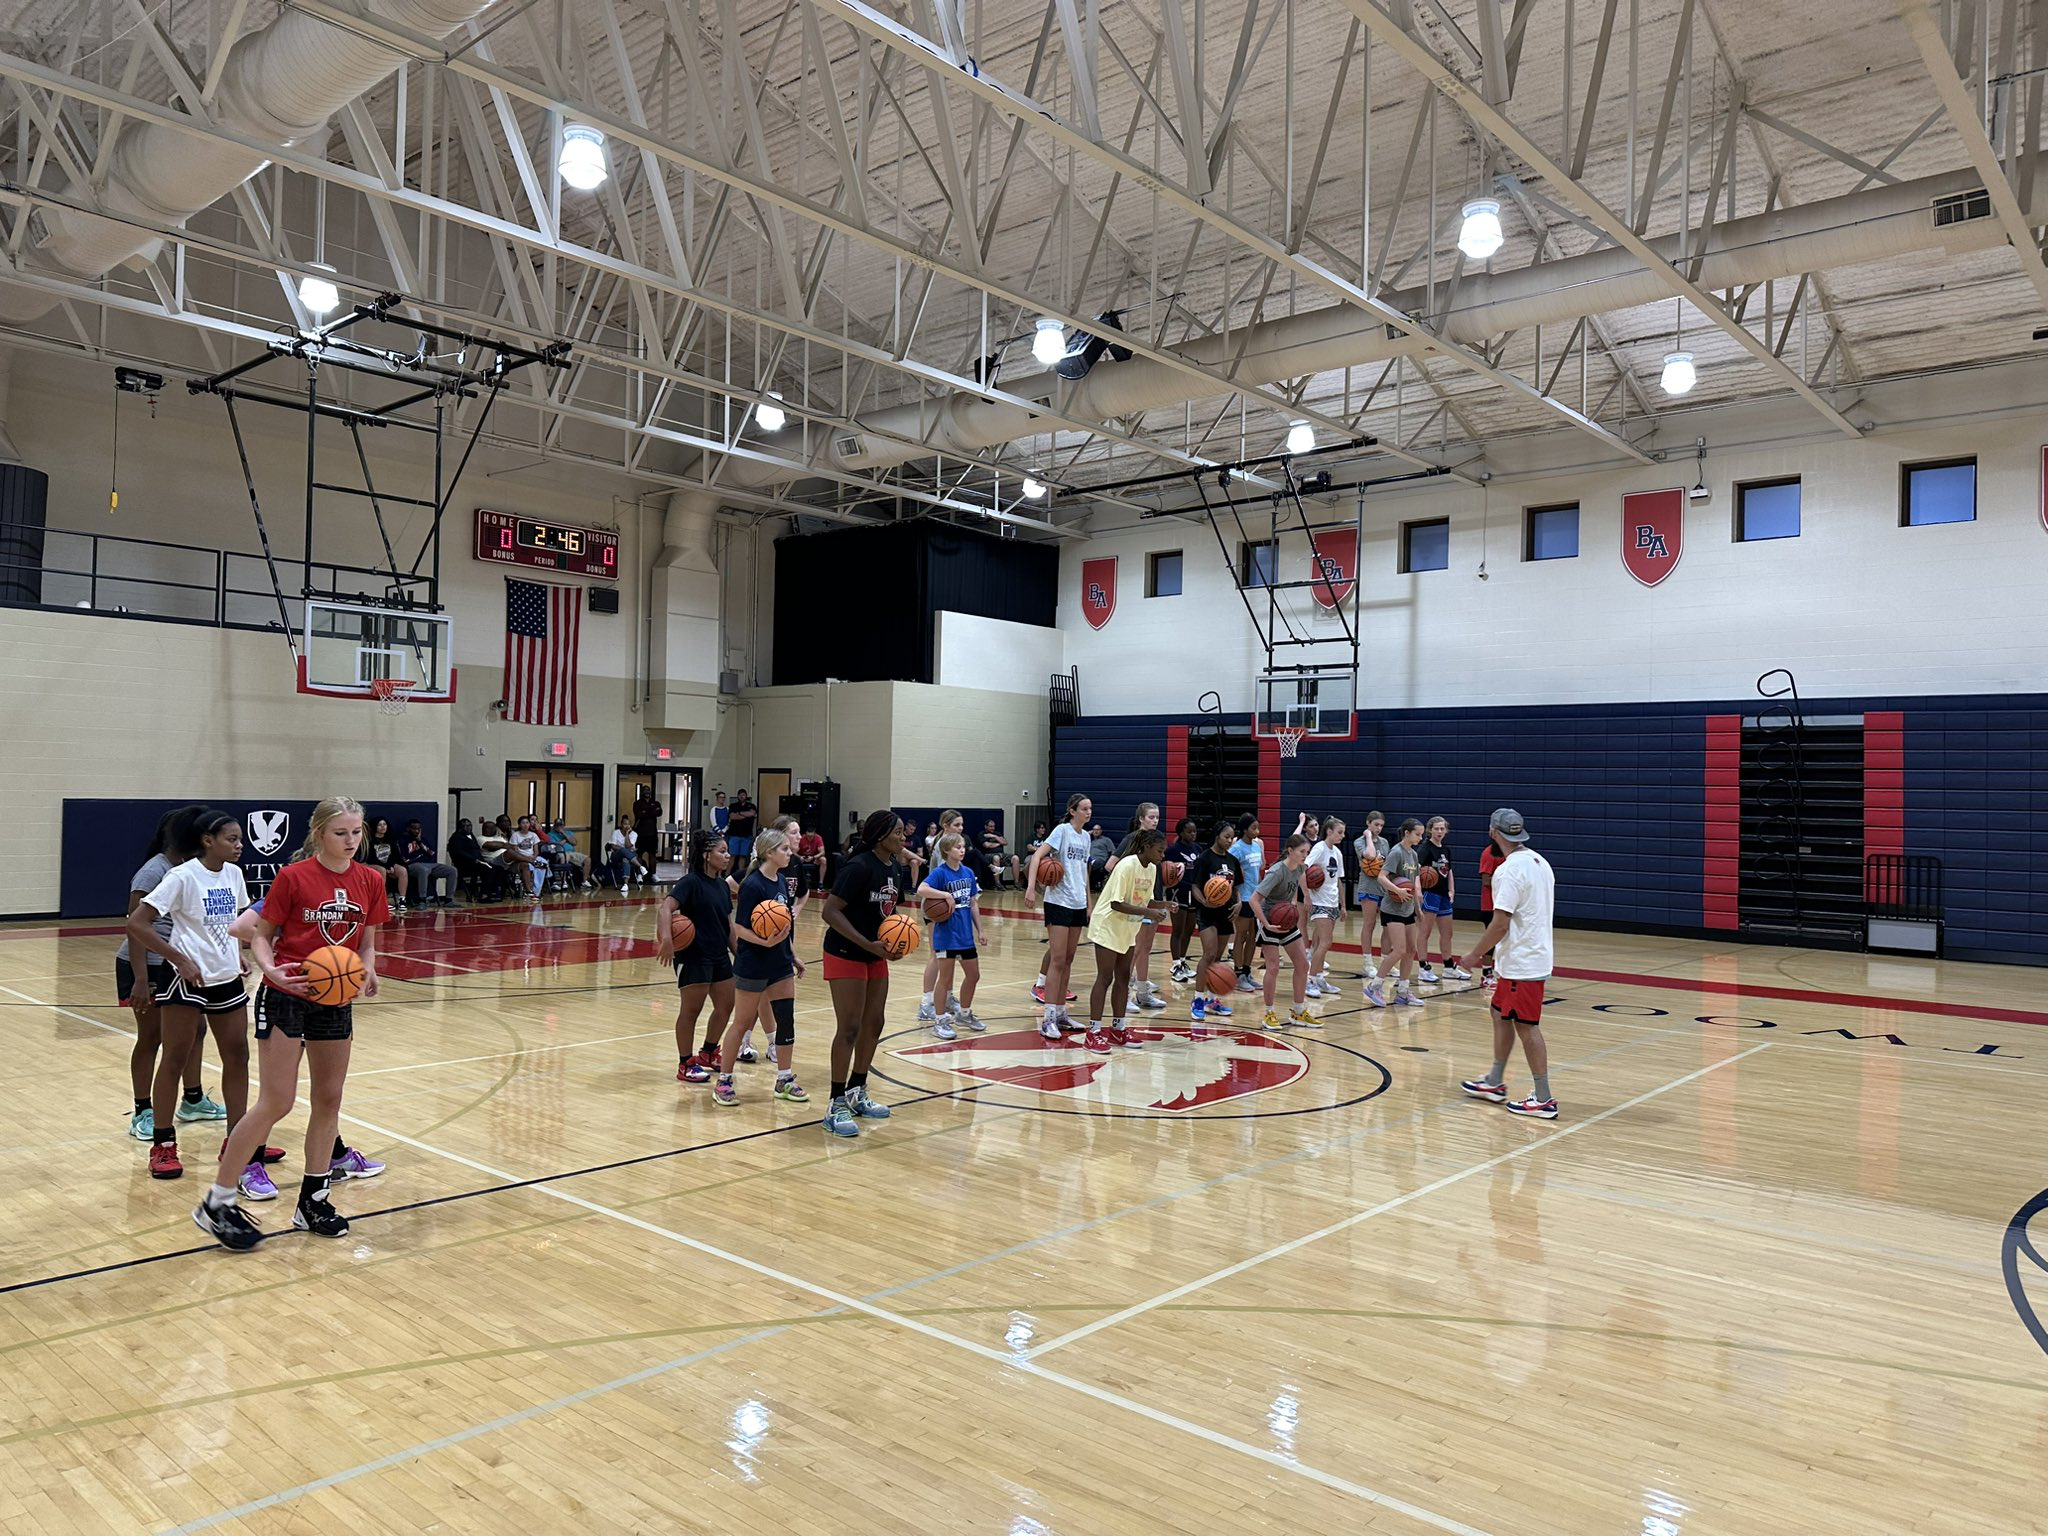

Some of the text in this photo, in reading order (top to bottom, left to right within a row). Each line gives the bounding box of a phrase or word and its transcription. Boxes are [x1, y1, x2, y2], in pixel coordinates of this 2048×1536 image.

[483, 513, 514, 528] HOME
[500, 528, 513, 549] 0
[587, 532, 618, 546] VISITOR
[1635, 524, 1670, 559] BA
[492, 549, 515, 561] BONUS
[534, 556, 555, 567] PERIOD
[603, 546, 614, 565] 0
[585, 563, 607, 576] BONUS
[1088, 582, 1108, 609] BA
[207, 887, 233, 898] MIDDLE
[202, 895, 236, 907] TENNESSE
[304, 909, 344, 921] BRANDAN
